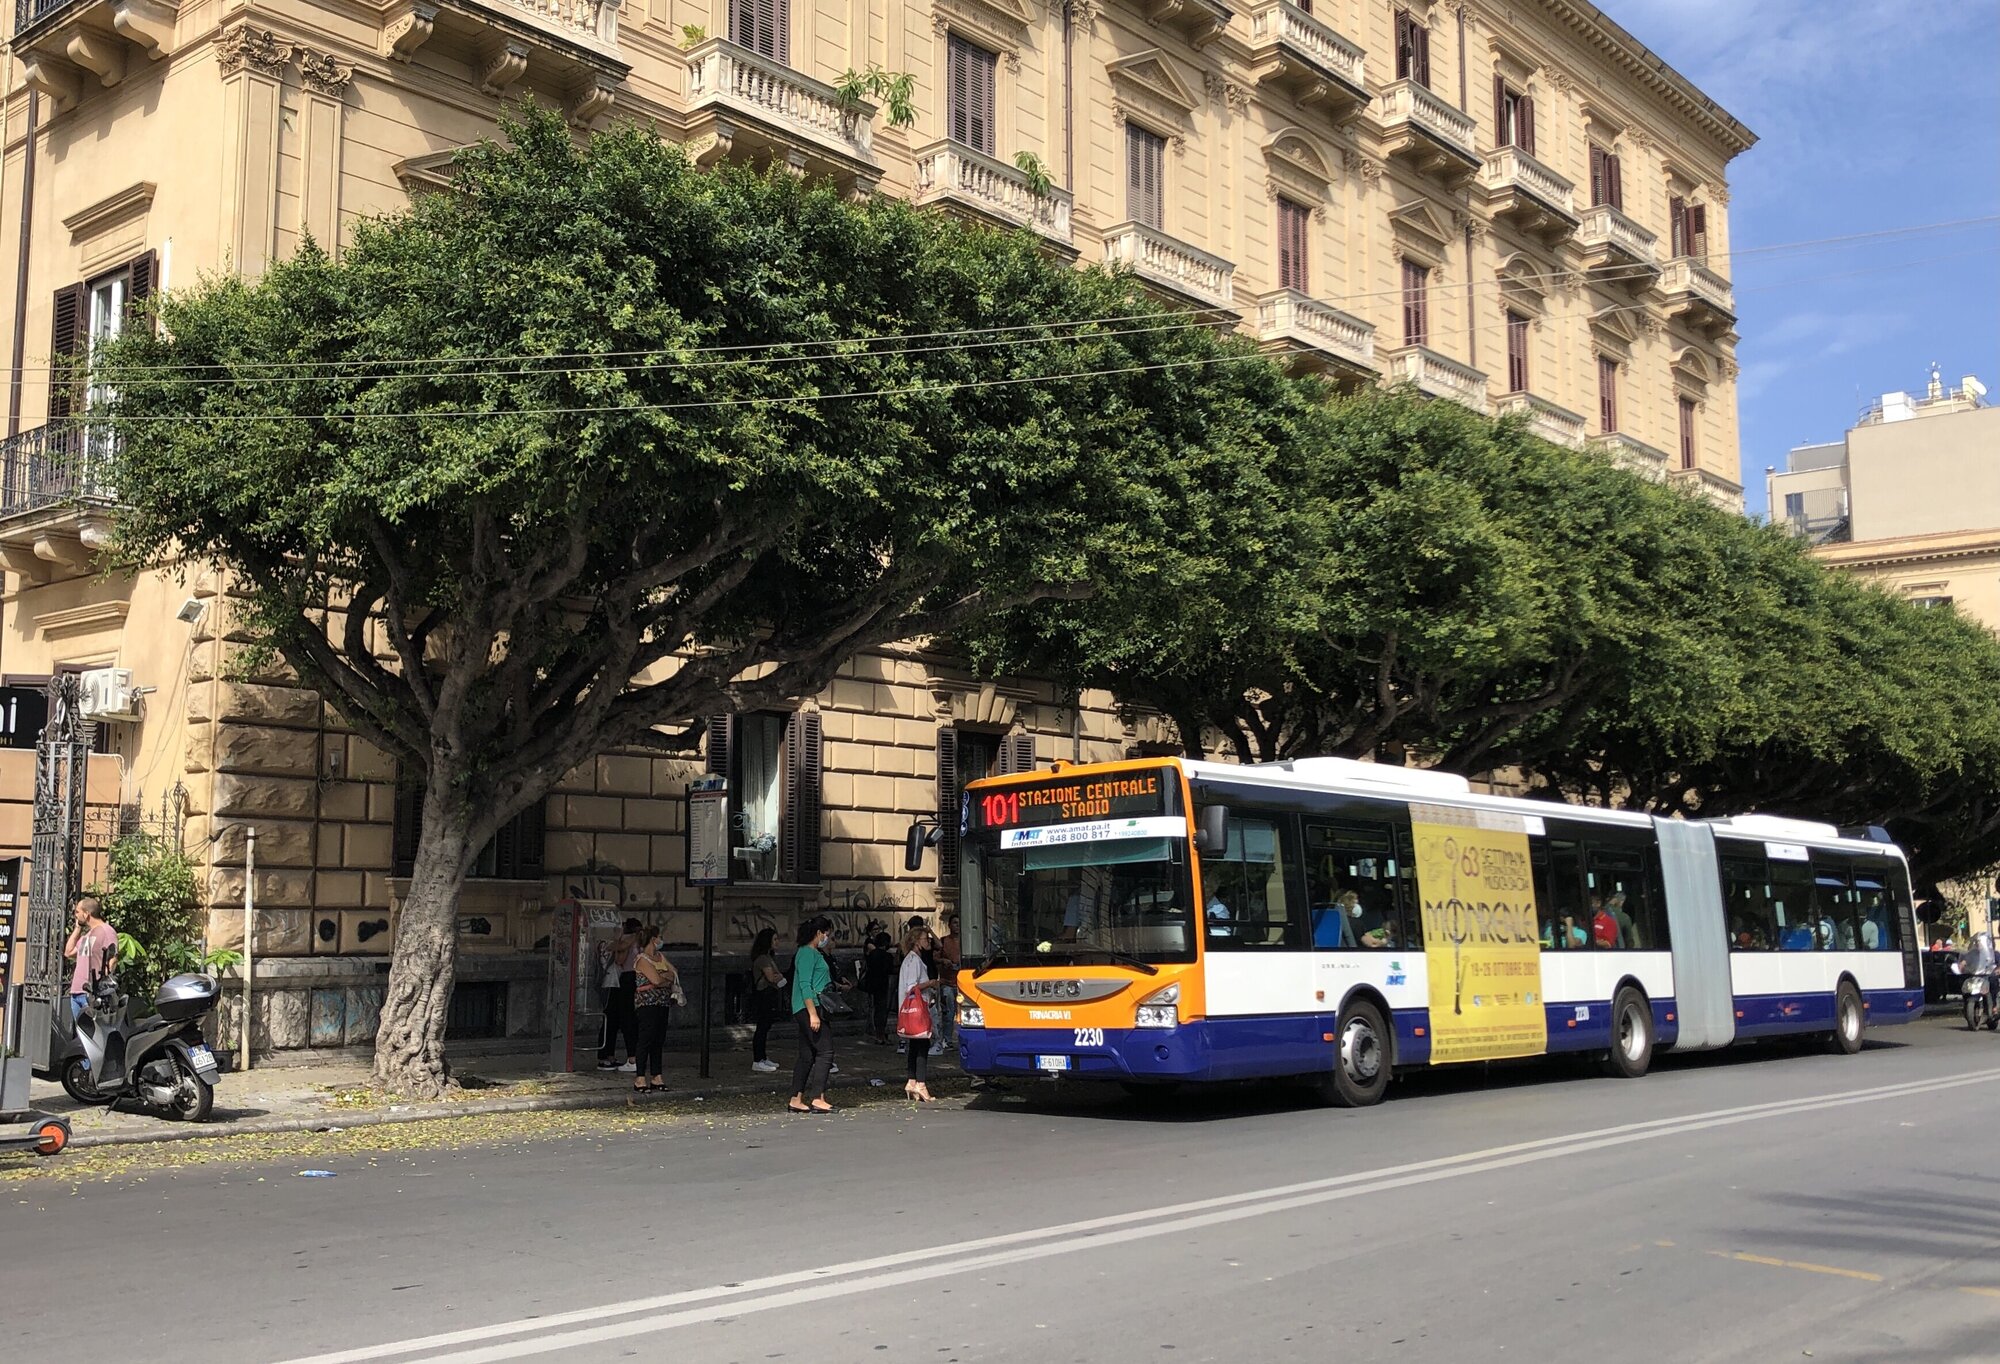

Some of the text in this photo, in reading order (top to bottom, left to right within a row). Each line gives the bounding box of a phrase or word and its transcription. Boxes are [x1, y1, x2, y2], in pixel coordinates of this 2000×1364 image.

[1019, 778, 1156, 807] STAZIONE CENTRALE
[982, 792, 1019, 826] 101
[1062, 800, 1110, 818] STADIO
[1046, 822, 1111, 835] www.amat.pa.it
[1049, 830, 1111, 843] 848 800 817
[1011, 839, 1043, 847] Informa
[1019, 980, 1082, 998] IVECO
[1074, 1028, 1104, 1047] 2230
